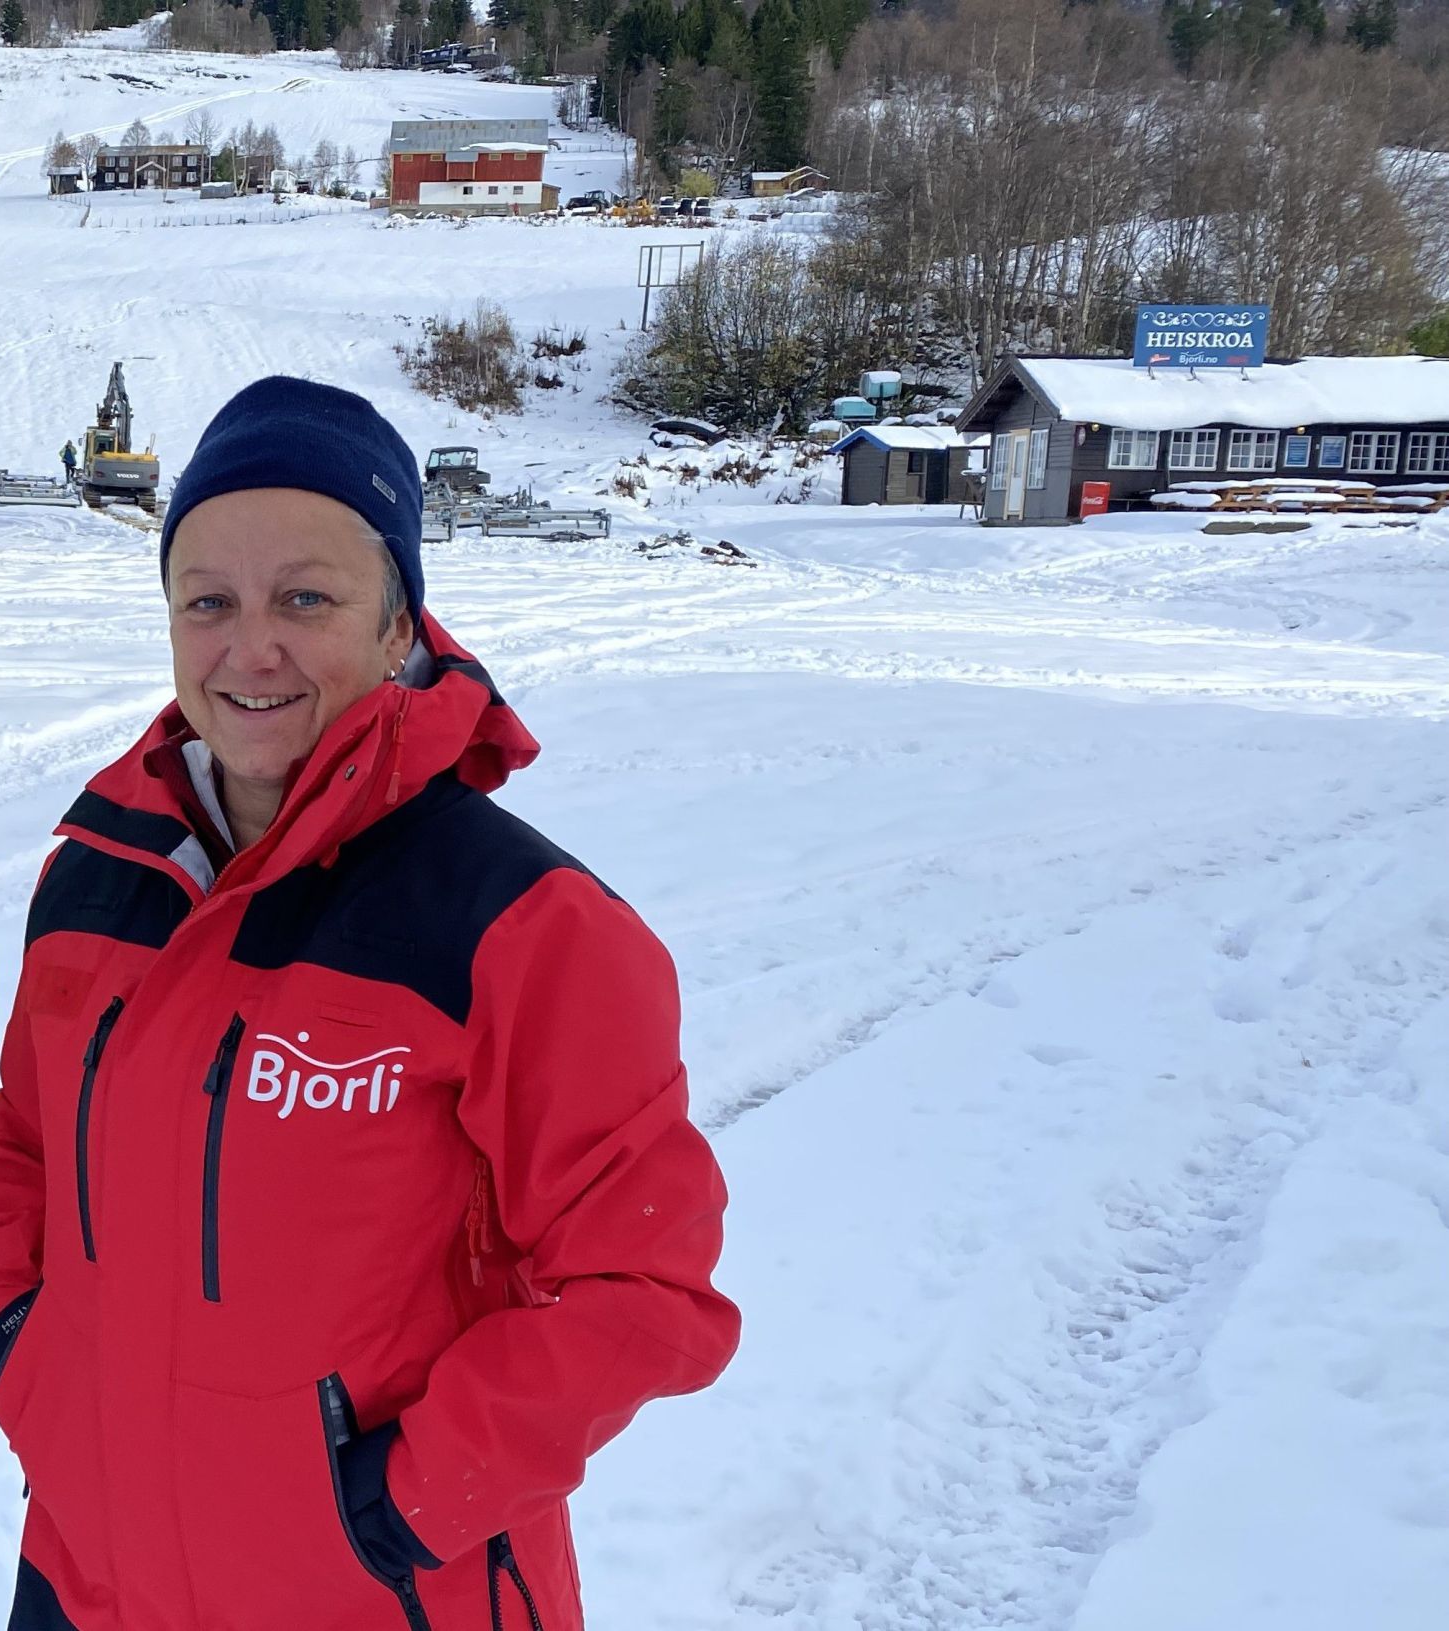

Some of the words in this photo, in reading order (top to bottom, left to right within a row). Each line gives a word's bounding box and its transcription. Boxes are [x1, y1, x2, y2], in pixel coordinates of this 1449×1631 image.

[1145, 331, 1255, 349] HEISKROA
[1178, 353, 1219, 365] Bjorli.no
[247, 1050, 404, 1119] Bjorli
